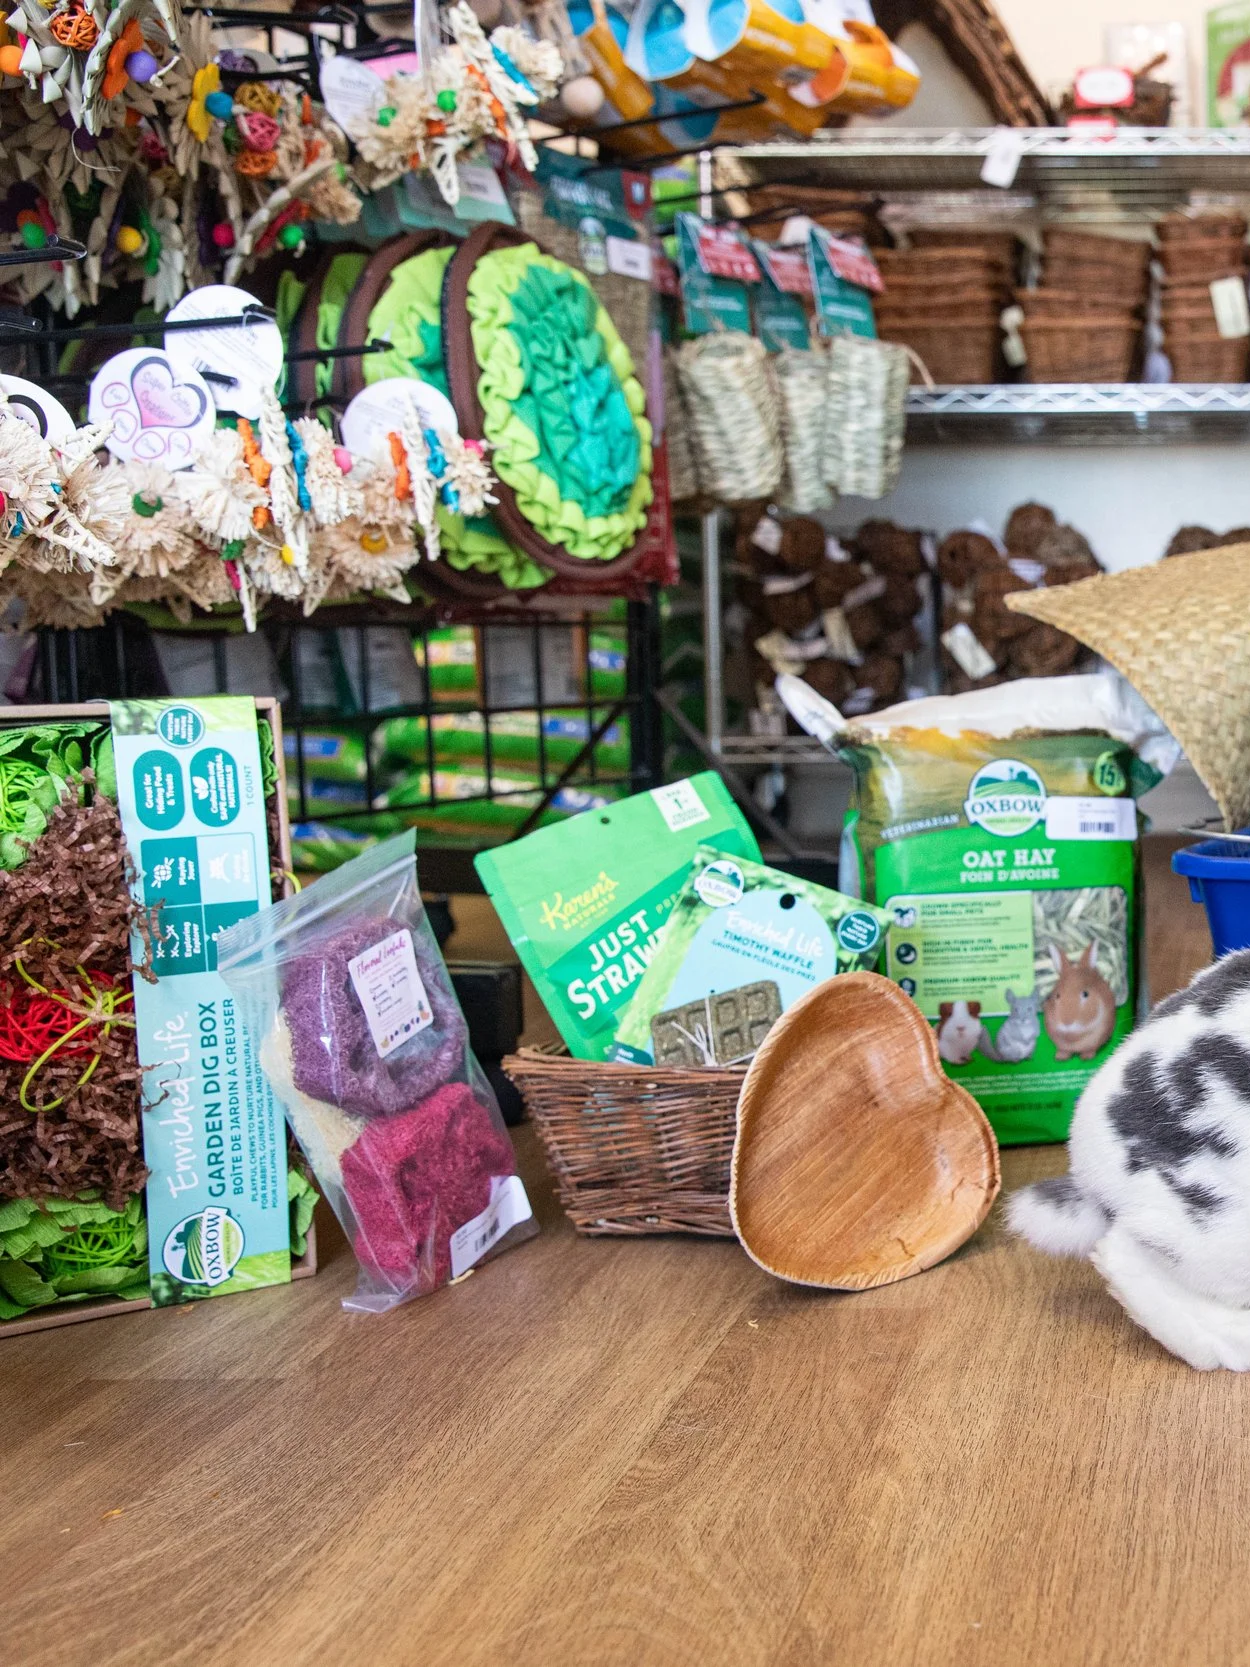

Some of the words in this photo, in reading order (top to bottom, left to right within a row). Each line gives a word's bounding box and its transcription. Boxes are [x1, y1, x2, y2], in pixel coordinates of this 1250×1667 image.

[143, 773, 152, 785] for
[153, 766, 163, 786] Food
[166, 773, 175, 798] Treats
[244, 765, 253, 799] COUNT
[145, 787, 154, 808] Great
[156, 788, 166, 814] Hiding
[971, 799, 1044, 816] OXBOW
[178, 857, 187, 885] Playing
[963, 851, 1006, 868] OAT
[1014, 849, 1056, 865] HAY
[960, 871, 994, 884] FOIN
[540, 871, 619, 930] Karen's
[183, 922, 193, 958] Exploring
[588, 909, 649, 972] JUST
[723, 930, 769, 953] TIMOTHY
[772, 946, 815, 970] WAFFLE
[726, 910, 795, 950] Enriched
[796, 932, 823, 957] Life
[153, 1015, 192, 1065] Life
[198, 1001, 218, 1048] BOX
[223, 998, 237, 1064] CREUSER
[202, 1056, 221, 1094] DIG
[225, 1068, 237, 1076] À
[244, 1039, 252, 1077] NATURAL
[246, 1079, 254, 1120] NURTURE
[255, 1076, 263, 1093] AND
[228, 1081, 241, 1130] JARDIN
[156, 1076, 199, 1198] Enriched
[231, 1134, 242, 1151] DE
[248, 1122, 255, 1132] TO
[258, 1120, 266, 1151] GUINEA
[204, 1102, 226, 1197] GARDEN
[230, 1155, 244, 1195] BOÎTE
[249, 1167, 258, 1202] PLAYFUL
[205, 1213, 223, 1279] OXBOW
